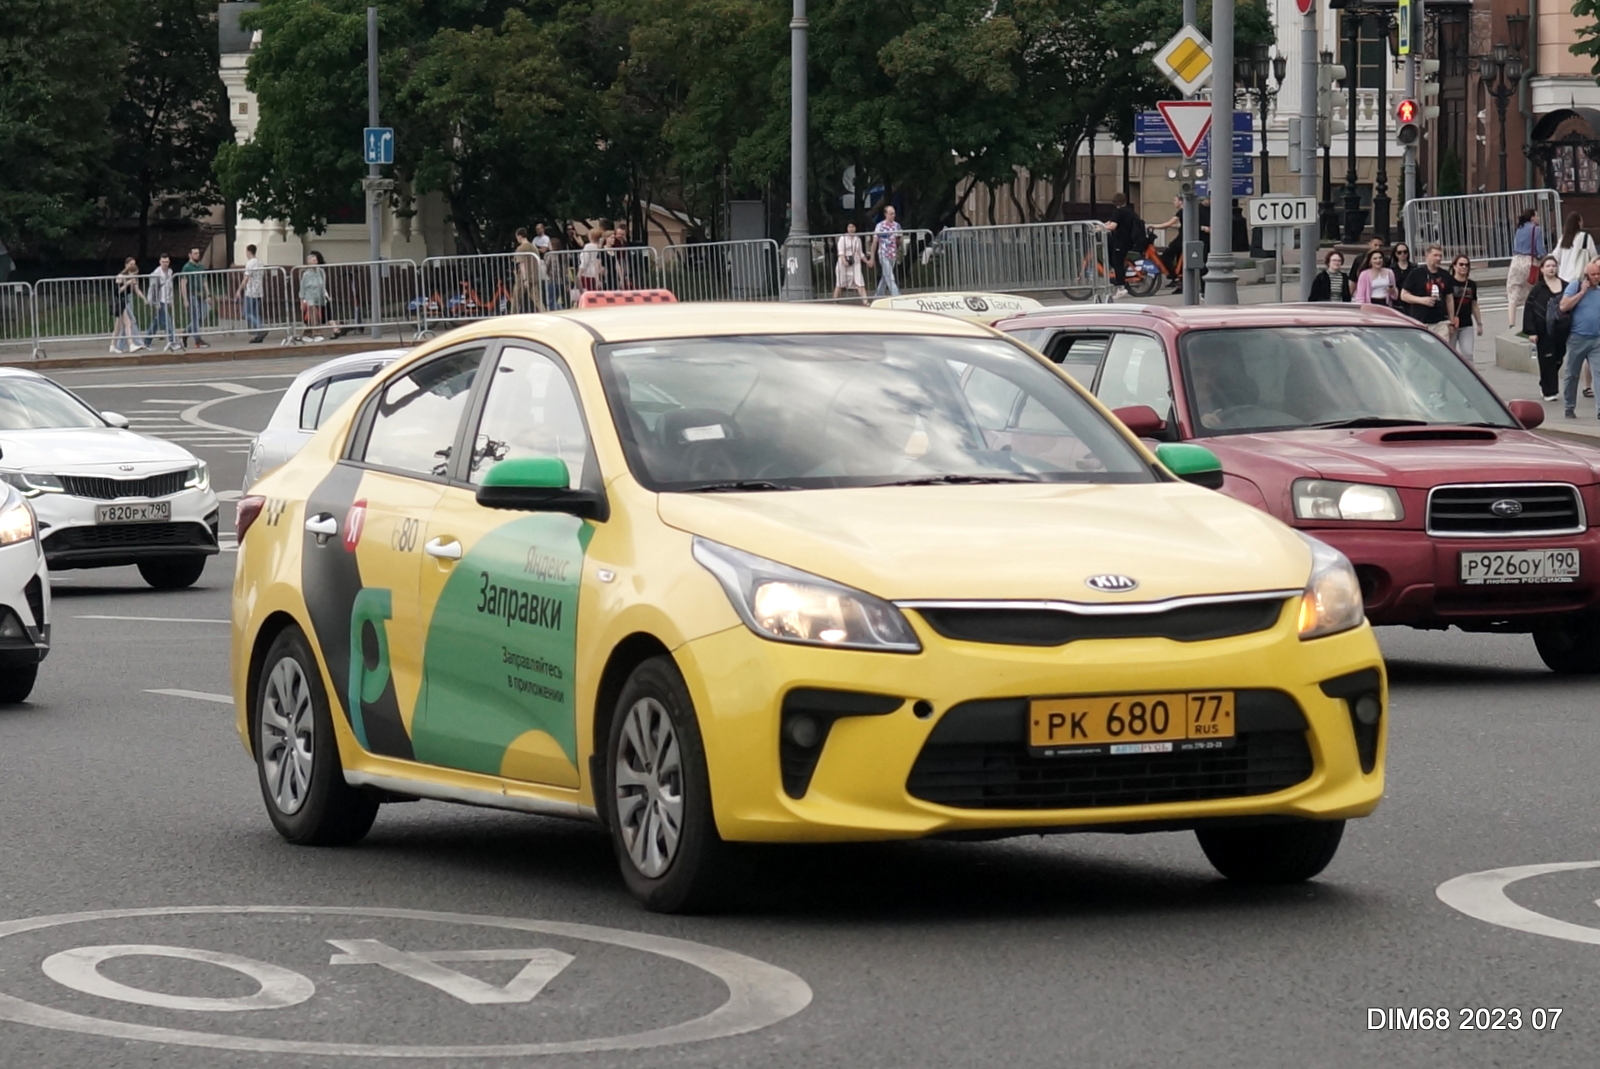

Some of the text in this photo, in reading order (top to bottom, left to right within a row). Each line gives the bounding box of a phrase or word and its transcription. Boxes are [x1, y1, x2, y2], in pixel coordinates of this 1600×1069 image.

[1257, 201, 1307, 221] СТОП
[916, 298, 1022, 312] Яндекс Go Такси
[149, 503, 167, 515] 790
[347, 507, 363, 543] Я
[523, 545, 571, 582] Яндекс
[1547, 552, 1575, 568] 190
[1094, 575, 1133, 587] KIA
[477, 570, 563, 631] Заправки
[502, 646, 563, 679] Заправляйтесь
[507, 674, 514, 688] в
[1106, 700, 1170, 737] 680
[1191, 696, 1223, 723] 77
[1194, 724, 1219, 735] RUS
